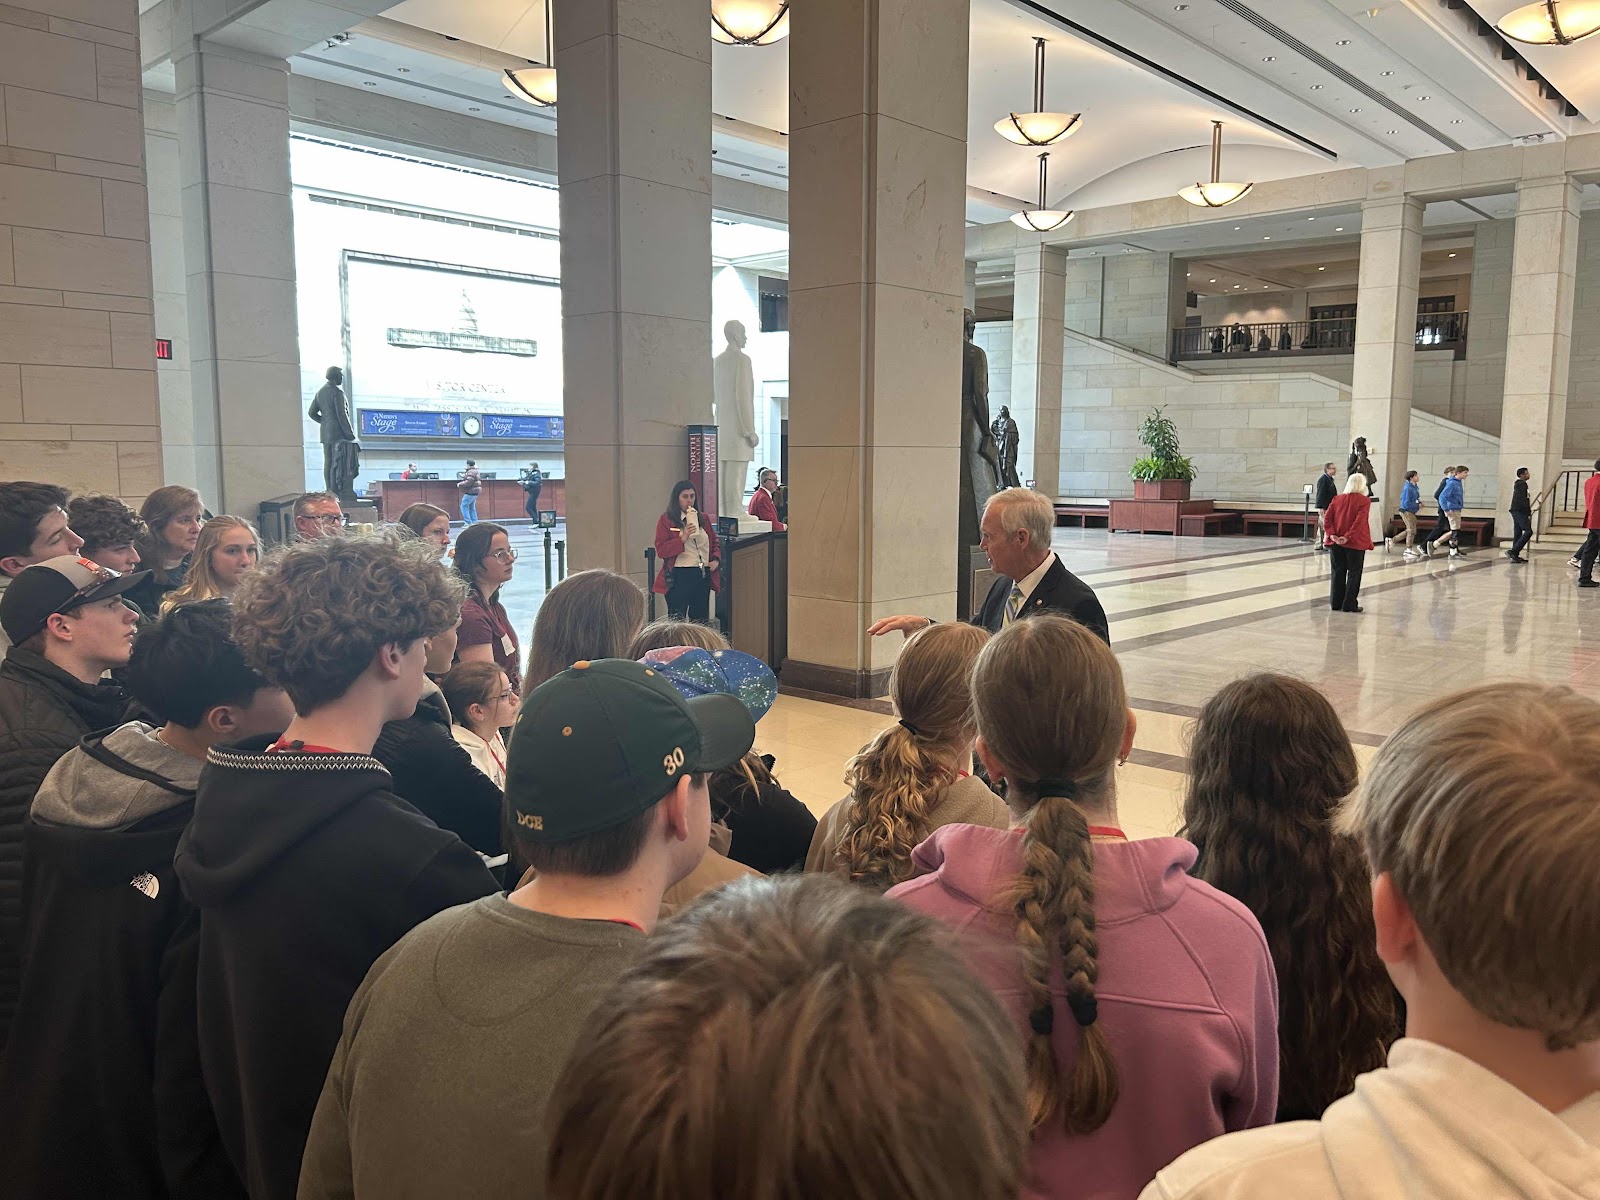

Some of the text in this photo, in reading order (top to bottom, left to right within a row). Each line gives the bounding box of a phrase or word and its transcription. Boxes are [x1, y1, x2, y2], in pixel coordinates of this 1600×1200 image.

[370, 415, 398, 434] Stage
[490, 419, 513, 436] Stage
[663, 746, 685, 776] 30
